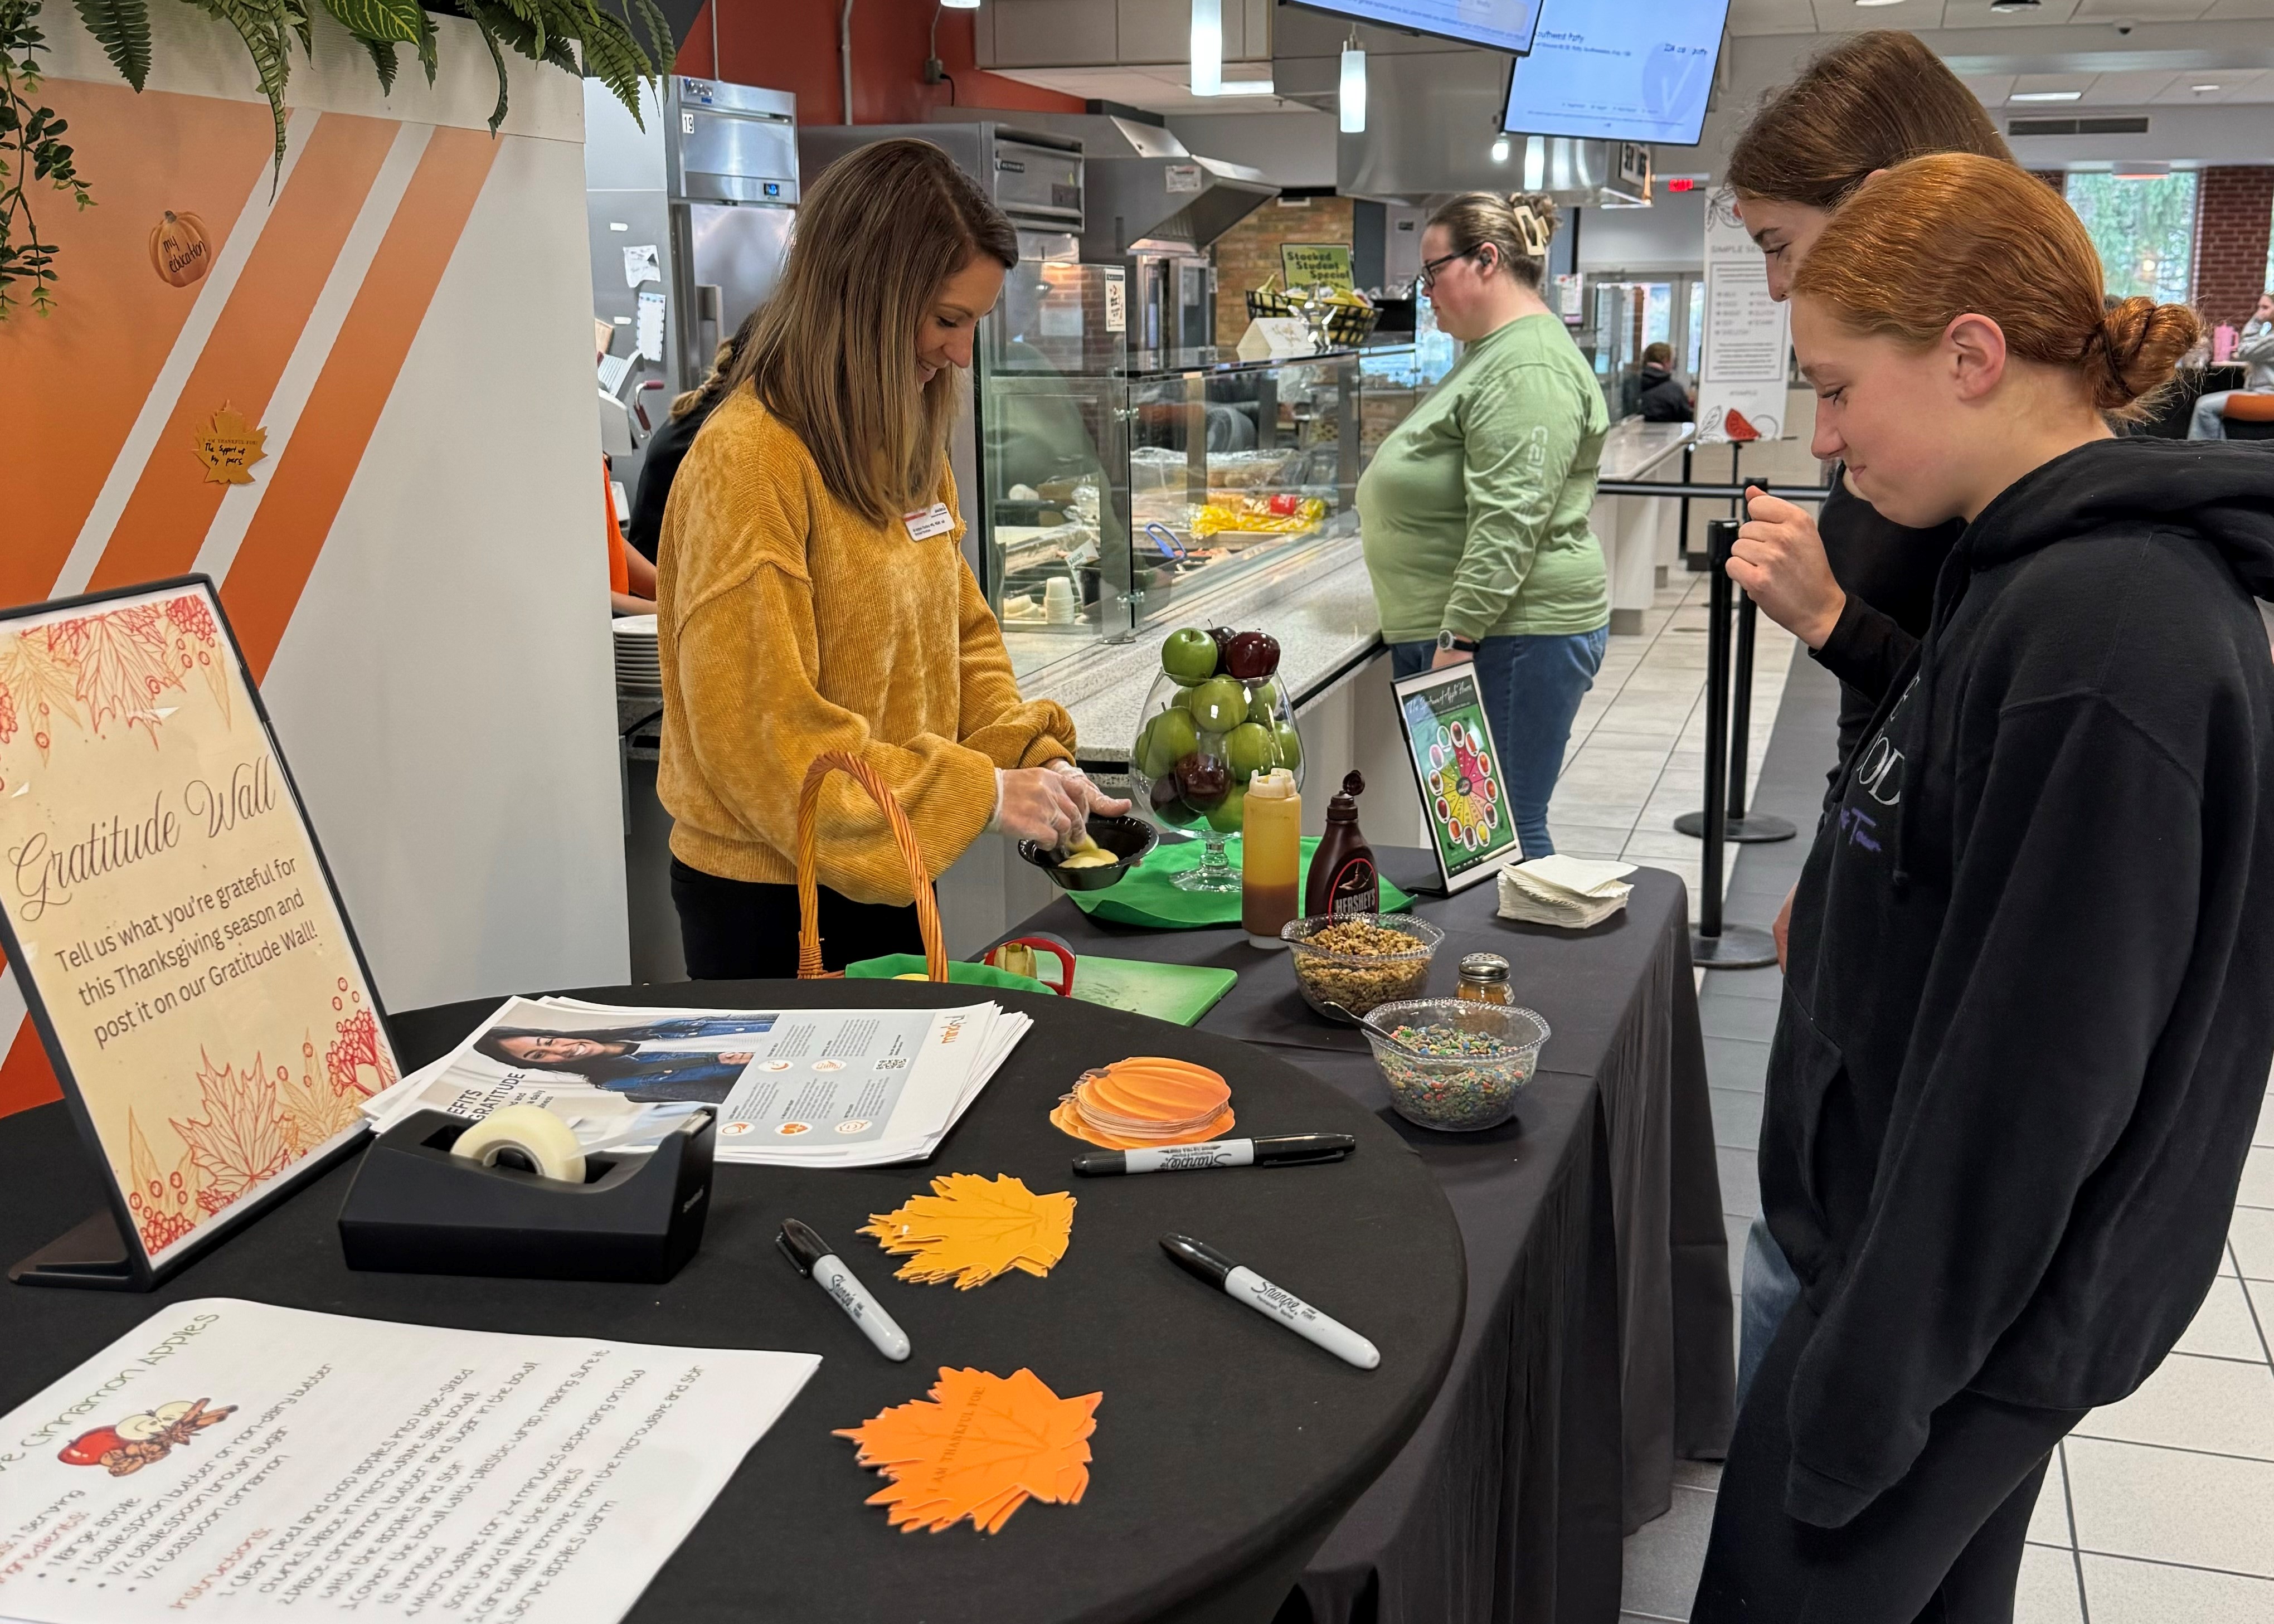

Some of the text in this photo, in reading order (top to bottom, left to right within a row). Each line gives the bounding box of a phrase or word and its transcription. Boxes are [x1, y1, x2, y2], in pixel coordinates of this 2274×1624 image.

[684, 116, 694, 132] 19
[169, 241, 206, 273] education
[1287, 251, 1332, 261] Stocked
[1296, 261, 1339, 270] Student
[1310, 270, 1350, 280] Special
[8, 754, 276, 921] Gratitude Wall
[55, 857, 297, 973] Tell us what you're grateful for
[79, 888, 305, 1006] this Thanksgiving season and
[94, 920, 319, 1049] post it on our Gratitude Wall!
[446, 1089, 483, 1115] EFITS
[468, 1073, 526, 1120] GRATITUDE
[21, 1368, 146, 1447] Cinnamon
[137, 1314, 220, 1366] Apples
[606, 1390, 626, 1403] on
[615, 1369, 646, 1389] how
[84, 1499, 172, 1565] tablespoon
[165, 1460, 217, 1499] butter
[215, 1447, 231, 1459] or
[232, 1398, 298, 1445] non-dairy
[287, 1364, 333, 1397] butter
[269, 1525, 305, 1550] peel
[298, 1504, 329, 1525] and
[324, 1476, 358, 1503] chop
[352, 1441, 399, 1475] apples
[390, 1418, 420, 1439] into
[412, 1369, 475, 1417] bite-sized
[382, 1465, 430, 1503] butter
[425, 1445, 453, 1463] and
[445, 1416, 480, 1444] sugar
[477, 1404, 495, 1414] in
[489, 1387, 513, 1403] the
[504, 1362, 541, 1385] bowl
[387, 1542, 420, 1561] the
[410, 1510, 451, 1539] bowl
[444, 1481, 480, 1508] with
[469, 1443, 517, 1479] plastic
[538, 1379, 580, 1414] making
[571, 1358, 600, 1378] sure
[527, 1510, 577, 1556] remove
[569, 1480, 604, 1509] from
[595, 1461, 621, 1478] the
[613, 1403, 673, 1460] microwave
[664, 1384, 689, 1402] and
[680, 1365, 704, 1384] stir
[560, 1403, 616, 1453] depending
[943, 1410, 974, 1462] THANKFUL
[126, 1492, 213, 1559] tablespoon
[205, 1455, 258, 1492] brown
[251, 1426, 289, 1455] sugar
[339, 1504, 362, 1515] in
[354, 1442, 426, 1503] microwave
[419, 1420, 450, 1440] safe
[515, 1453, 566, 1499] minutes
[20, 1490, 86, 1533] serving
[54, 1530, 100, 1560] large
[95, 1497, 142, 1528] apple
[156, 1507, 230, 1564] teaspoon
[225, 1454, 291, 1506] cinnamon
[319, 1460, 466, 1598] with the apples and stir
[478, 1517, 504, 1535] for
[500, 1528, 530, 1546] like
[522, 1506, 549, 1525] the
[541, 1468, 584, 1504] apples
[542, 1537, 587, 1577] apples
[579, 1500, 618, 1535] warm
[0, 1512, 91, 1584] ngredients:
[169, 1528, 275, 1610] Instructions:
[395, 1547, 447, 1589] vented
